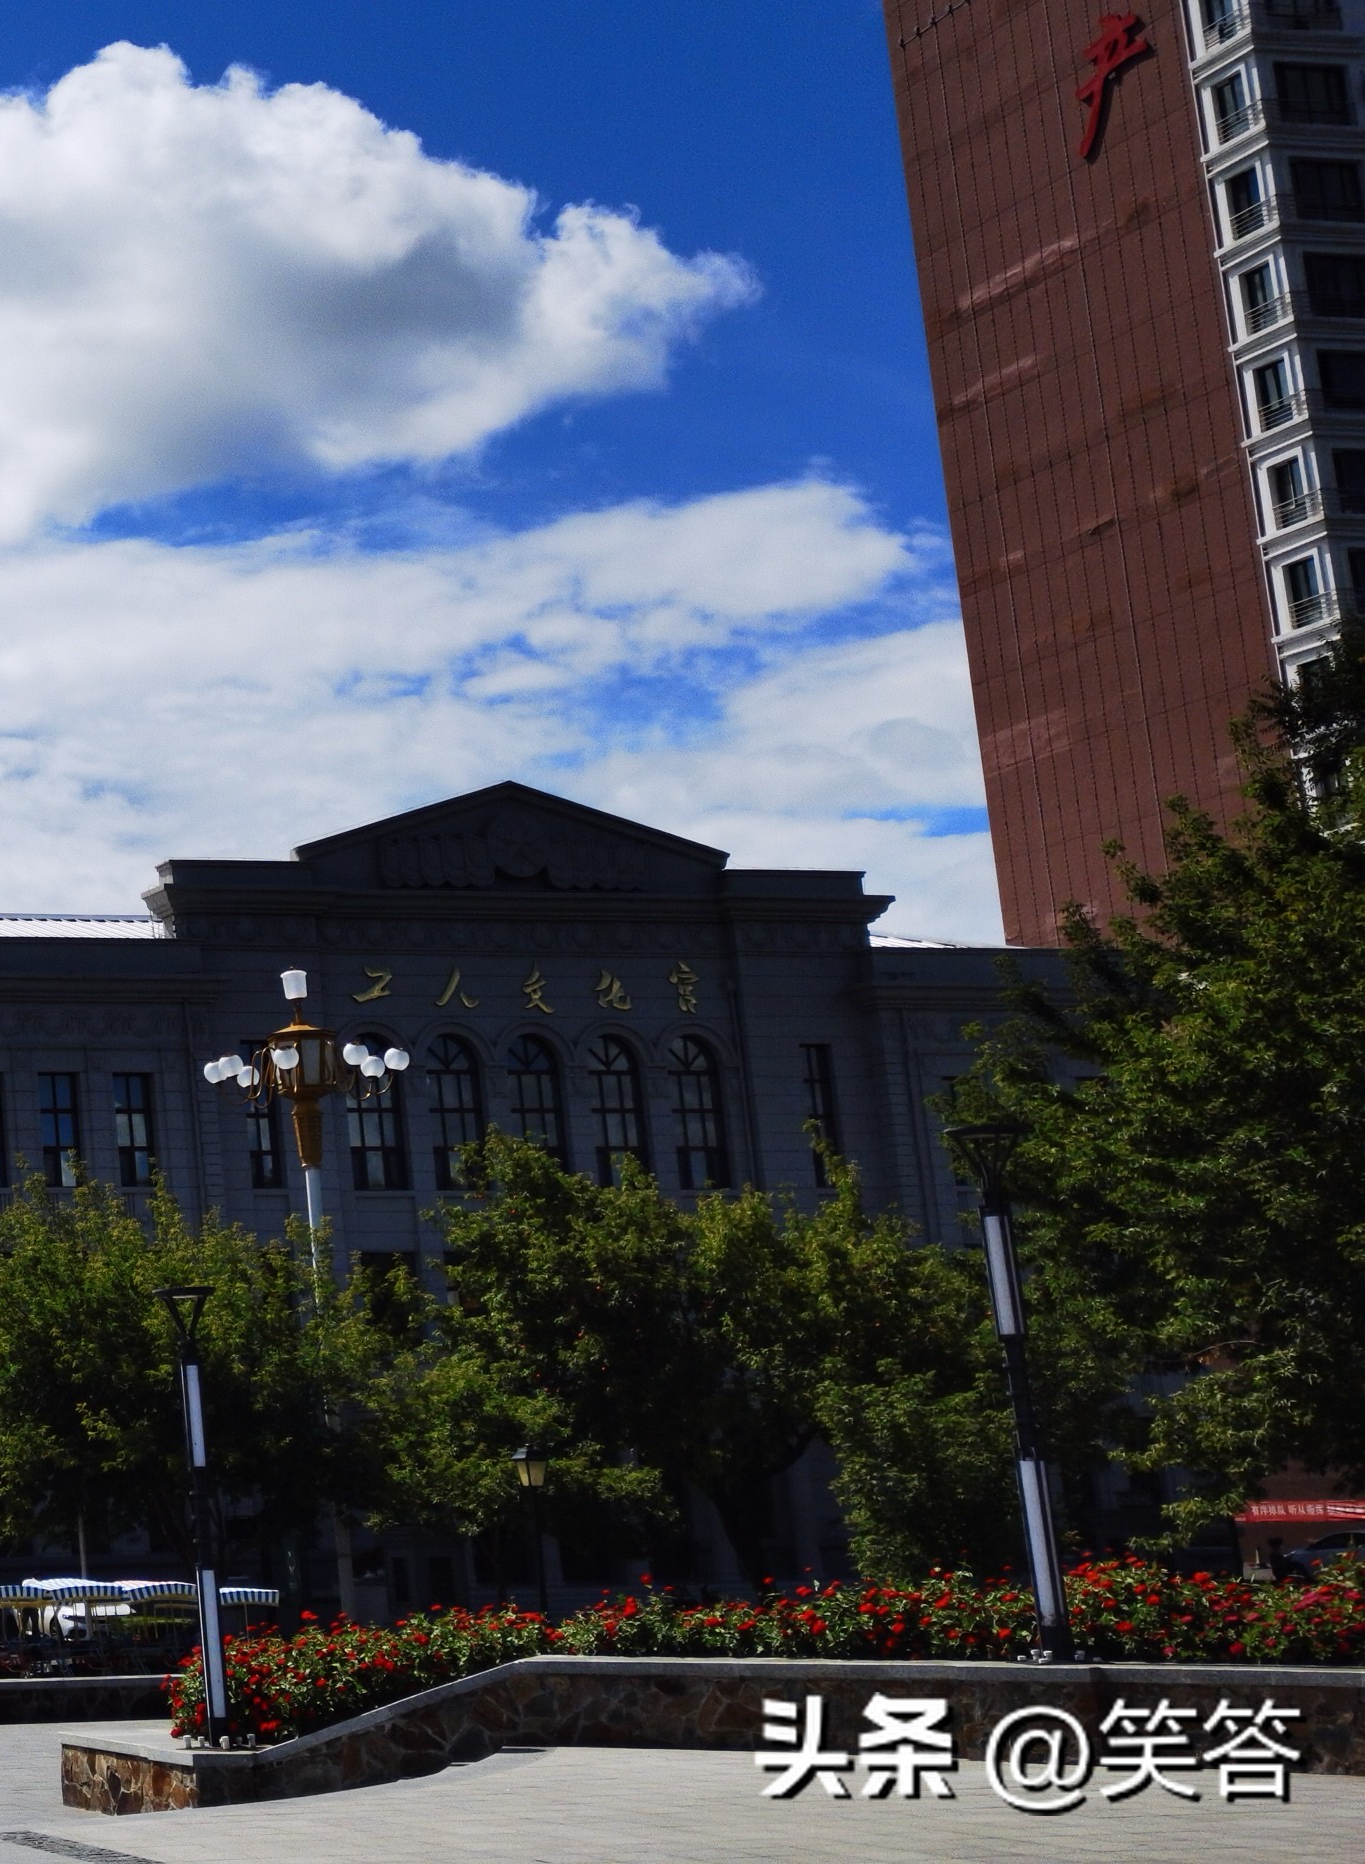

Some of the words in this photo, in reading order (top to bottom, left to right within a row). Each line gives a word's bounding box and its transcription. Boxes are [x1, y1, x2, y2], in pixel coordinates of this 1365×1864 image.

[351, 960, 701, 1015] 工人文化宫
